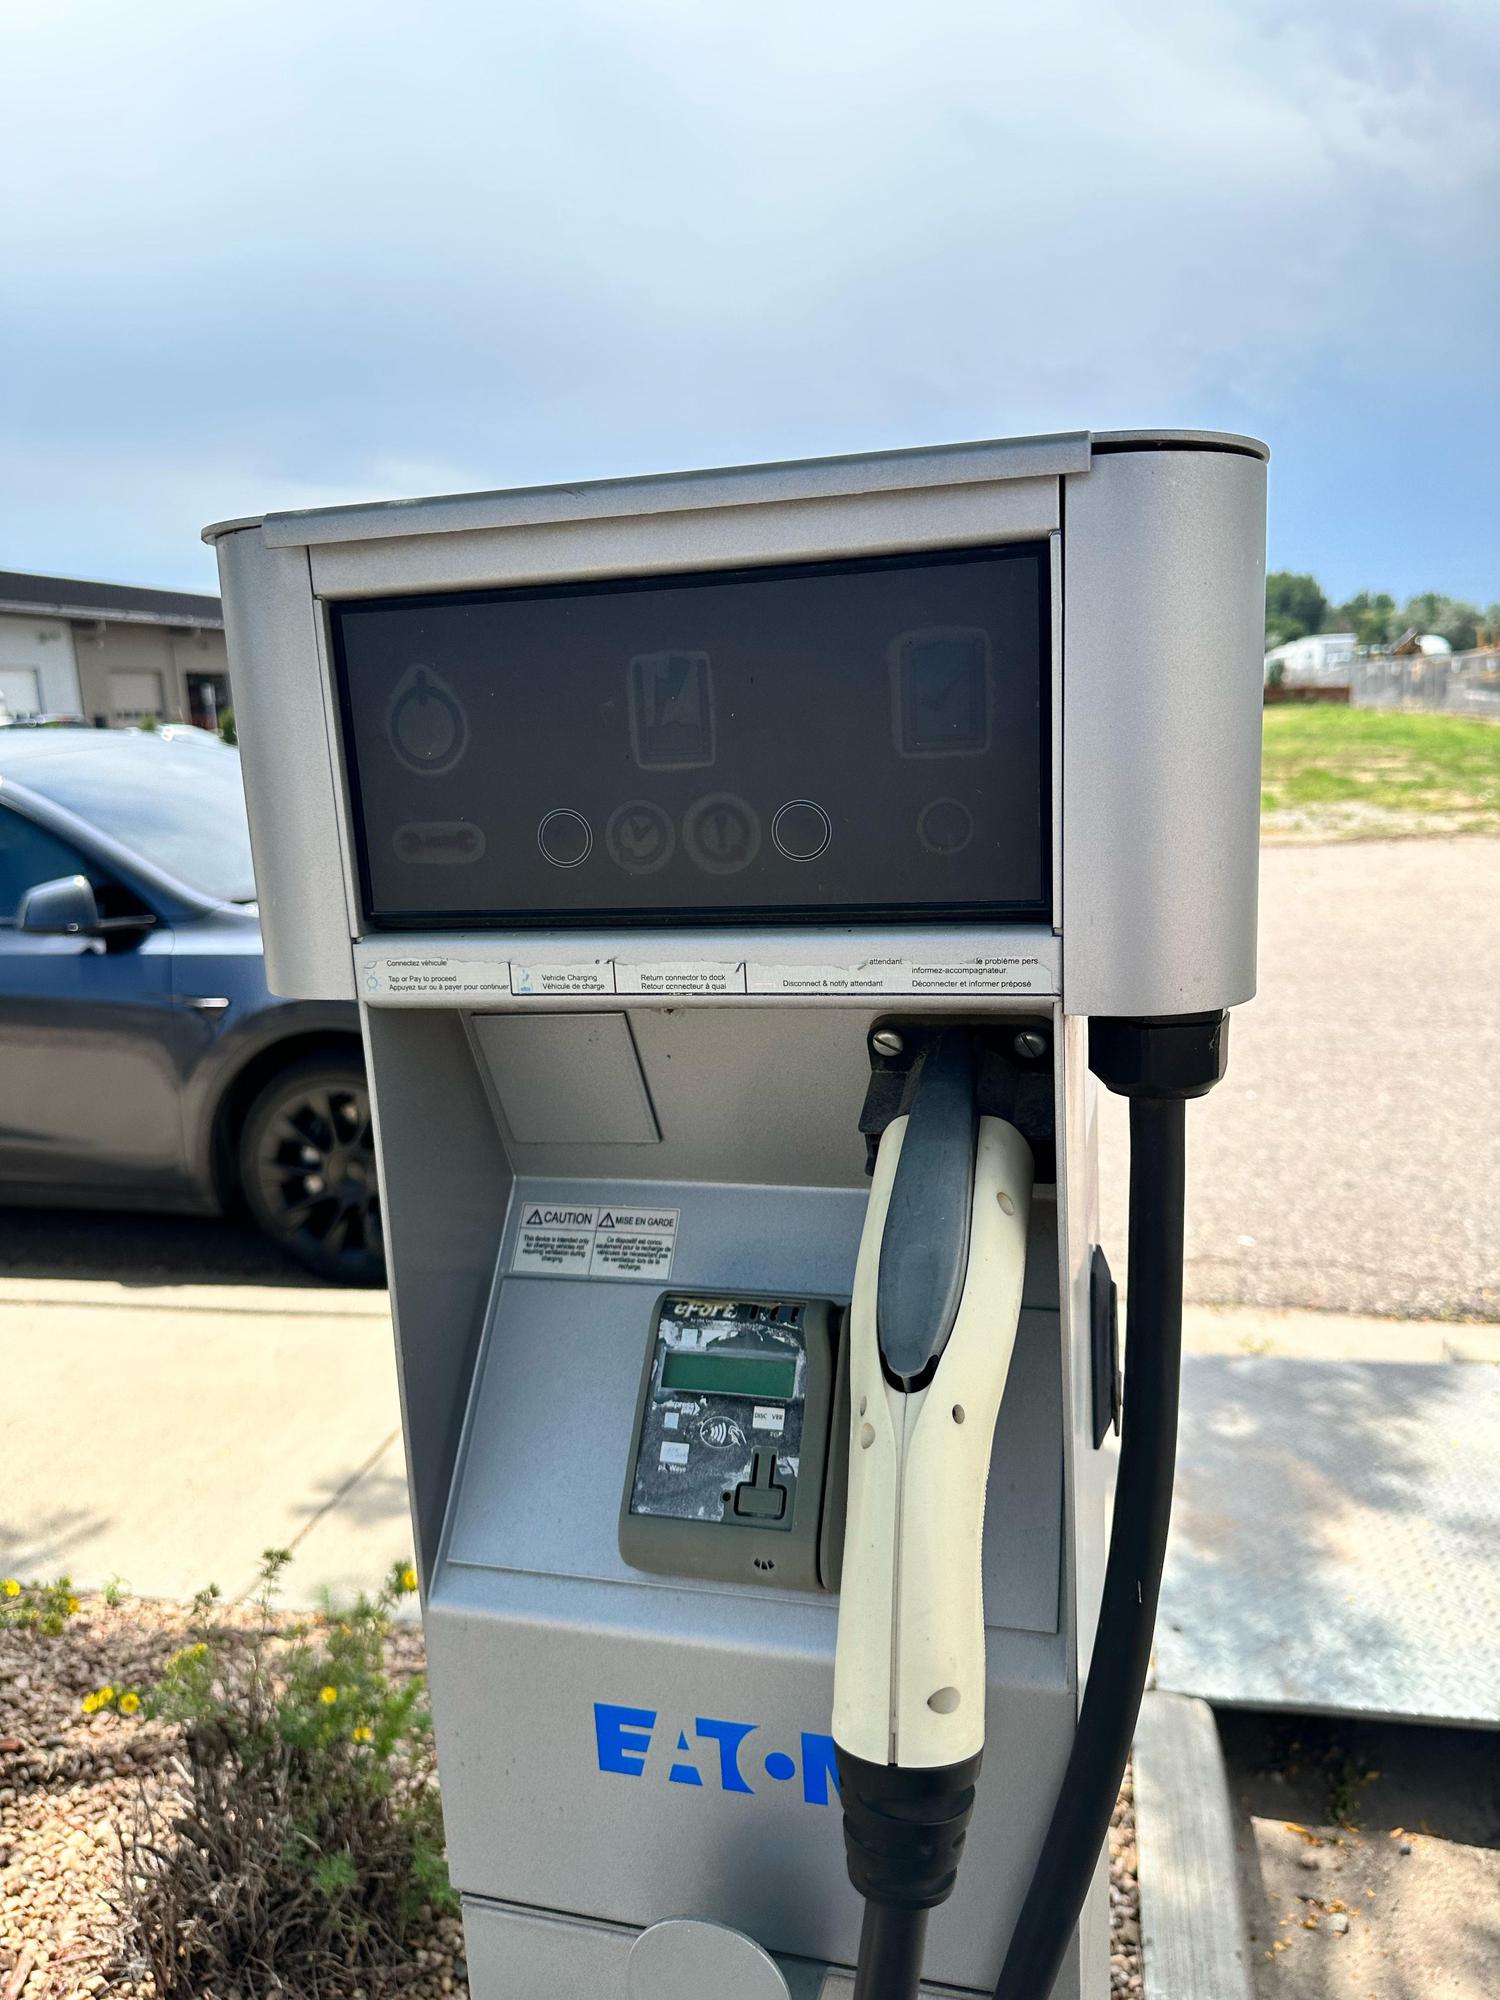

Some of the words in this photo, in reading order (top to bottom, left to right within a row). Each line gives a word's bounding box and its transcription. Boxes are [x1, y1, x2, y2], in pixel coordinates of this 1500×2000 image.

[985, 958, 1019, 966] problème
[431, 975, 456, 983] proceed
[567, 974, 598, 983] Charging
[389, 983, 416, 991] Appuyez
[582, 983, 605, 991] charge
[711, 983, 727, 991] quai
[830, 980, 848, 988] notify
[912, 980, 958, 988] Déconnecter
[1001, 980, 1032, 988] préposé
[544, 1212, 593, 1225] CAUTION
[615, 1216, 633, 1225] MISE
[635, 1217, 646, 1226] EN
[648, 1217, 674, 1228] GARDE
